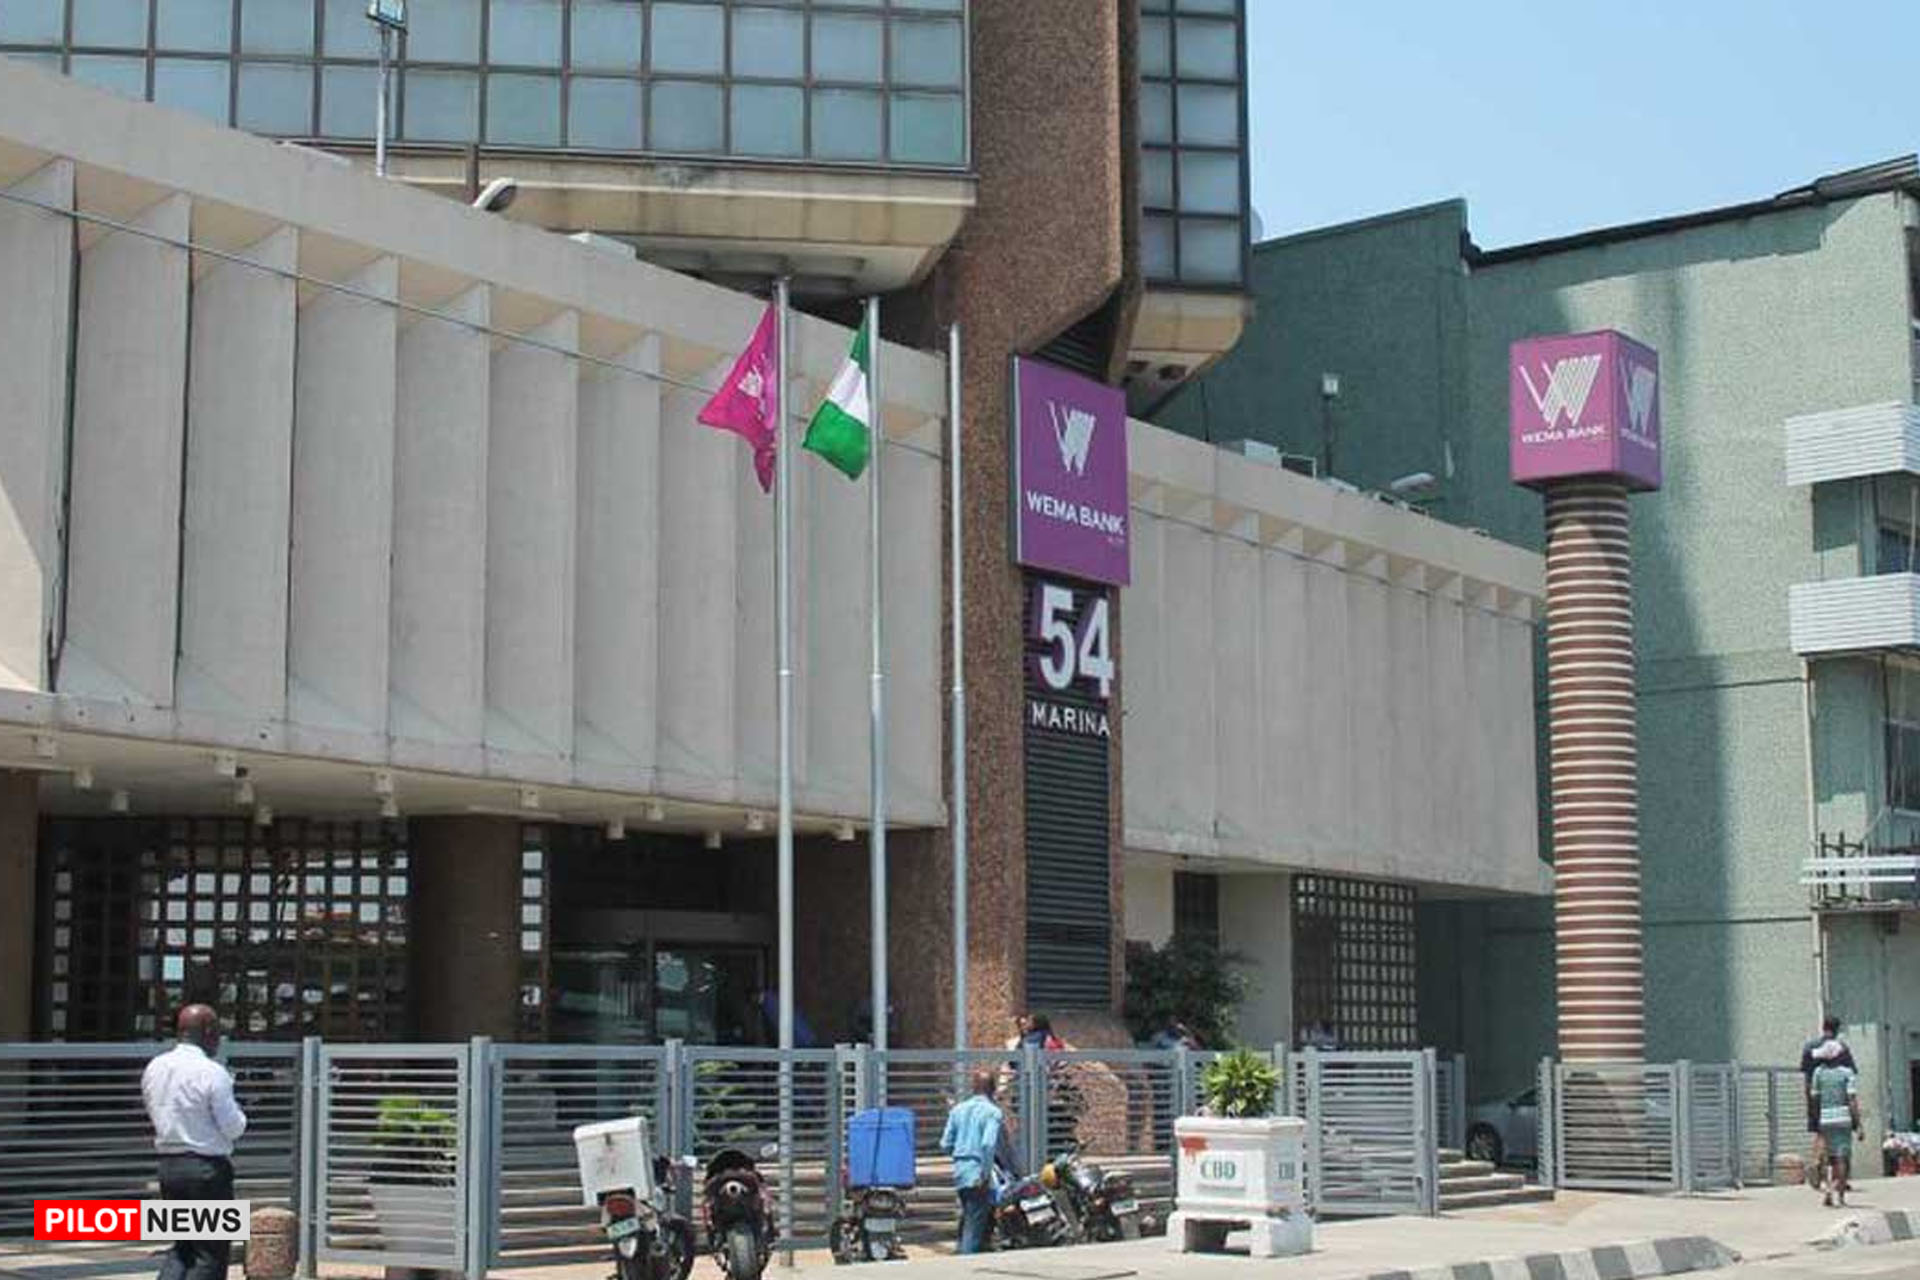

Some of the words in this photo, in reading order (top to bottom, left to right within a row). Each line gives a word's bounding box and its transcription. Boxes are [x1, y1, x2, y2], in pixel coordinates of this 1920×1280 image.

[1026, 490, 1079, 525] WEMA
[1080, 506, 1125, 536] BANK
[1039, 584, 1115, 697] 54
[1031, 701, 1110, 737] MARINA
